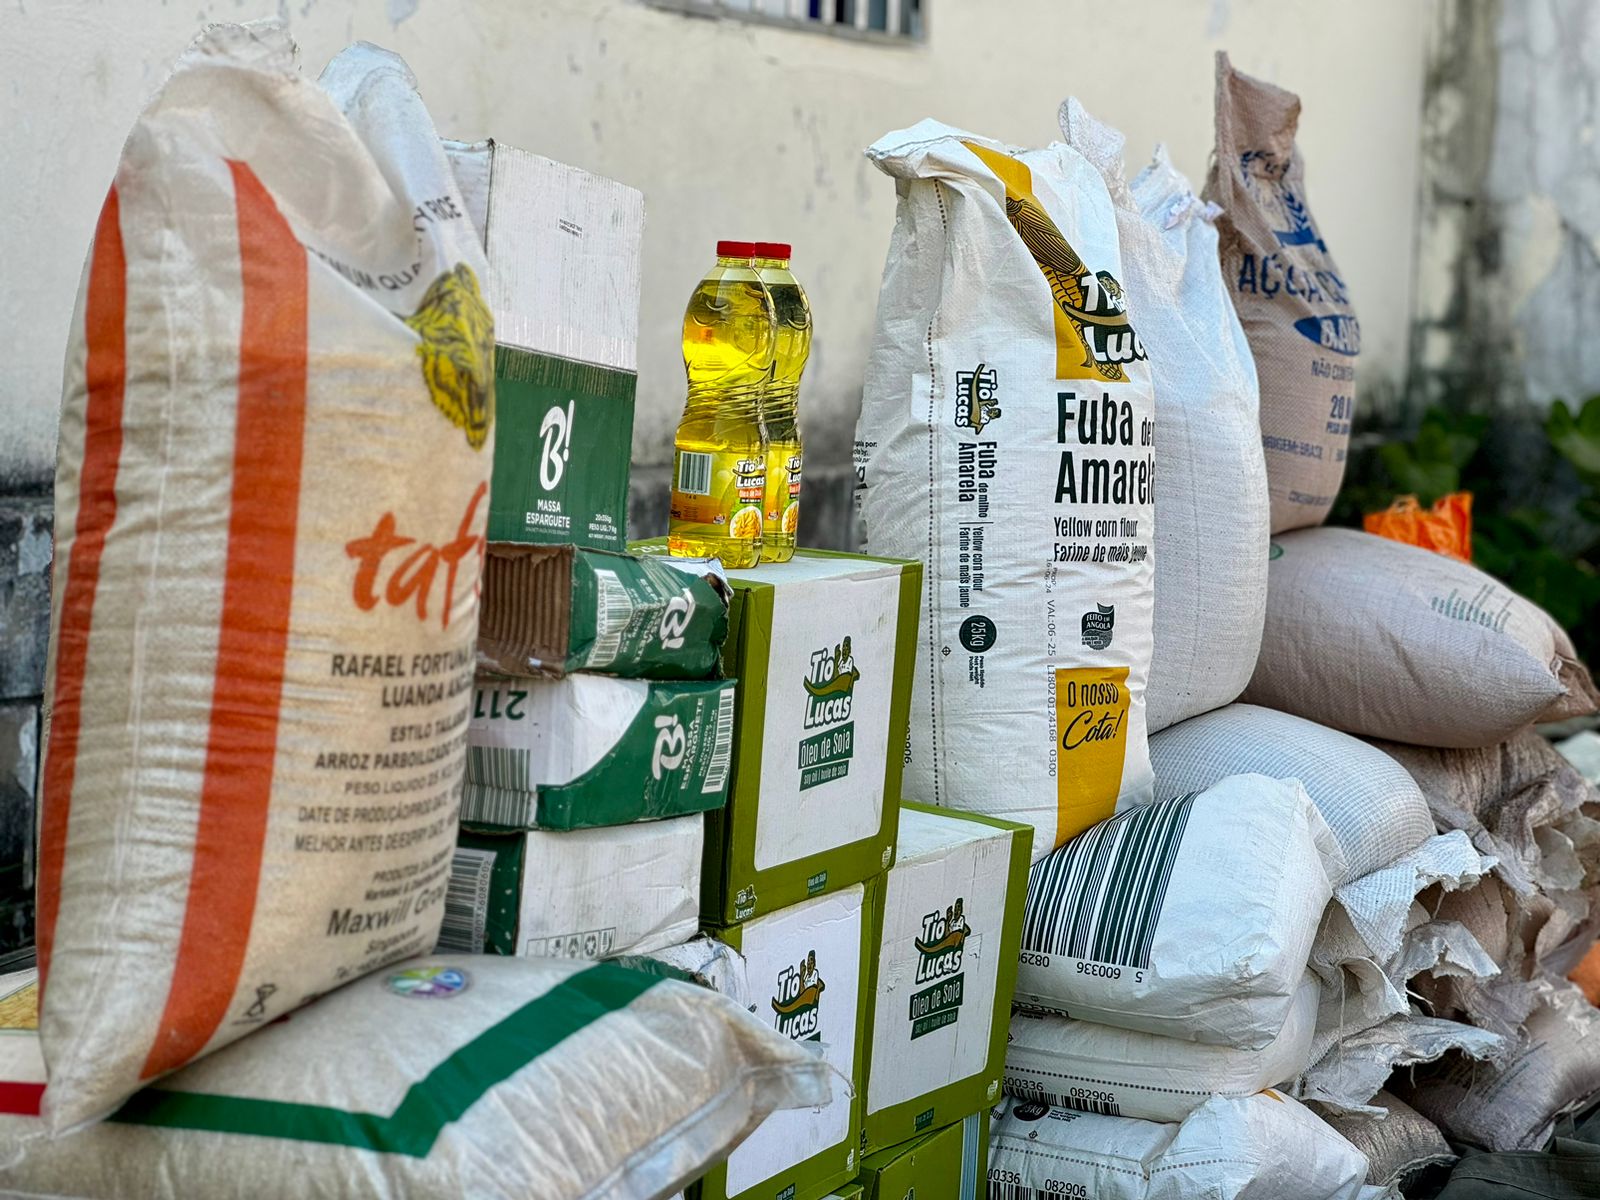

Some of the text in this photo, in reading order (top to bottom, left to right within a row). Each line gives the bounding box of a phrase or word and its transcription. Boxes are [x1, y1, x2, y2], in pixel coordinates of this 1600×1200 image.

[424, 196, 462, 221] RICE
[957, 371, 974, 427] Lucas
[979, 370, 998, 401] Tio
[1057, 392, 1134, 446] Fuba
[1141, 416, 1152, 447] de
[738, 460, 755, 472] Tio
[958, 442, 977, 502] Amarela
[978, 441, 998, 518] Fuba de milho
[736, 475, 764, 487] Lucas
[537, 499, 561, 512] MASSA
[526, 512, 571, 528] ESPARGUETE
[1054, 516, 1138, 537] Yellow corn flour
[973, 526, 984, 592] Yellow corn flour
[1053, 542, 1090, 562] Farine
[1092, 542, 1106, 562] de
[1107, 542, 1130, 563] maïs
[958, 527, 971, 608] Farine de maïs jaune
[1086, 613, 1103, 622] FEITO
[1086, 620, 1111, 630] ANGOLA
[969, 622, 986, 647] 25kg
[331, 653, 405, 677] RAFAEL
[811, 650, 835, 684] Tio
[382, 682, 444, 708] LUANDA
[1067, 680, 1119, 708] O nosso
[805, 695, 851, 728] Lucas
[390, 722, 432, 742] ESTILO
[1062, 709, 1125, 750] Cota!
[680, 697, 704, 790] ESPARGUETE
[682, 720, 695, 769] MASSA
[801, 729, 850, 767] Óleo de Soja
[315, 753, 370, 769] ARROZ
[1048, 748, 1057, 777] 0300
[345, 781, 380, 795] PESO
[298, 806, 331, 823] DATE
[334, 807, 350, 823] DE
[294, 834, 346, 852] MELHOR
[349, 833, 382, 851] ANTES
[327, 895, 413, 937] Maxwill
[923, 911, 946, 944] Tio
[917, 950, 962, 983] Lucas
[1076, 961, 1121, 980] 600336
[1135, 971, 1143, 983] 5
[778, 968, 801, 1004] Tio
[912, 980, 960, 1019] Óleo de Soja
[775, 1007, 818, 1040] Lucas
[1070, 1087, 1115, 1103] 082906
[1044, 1178, 1087, 1197] 082906
